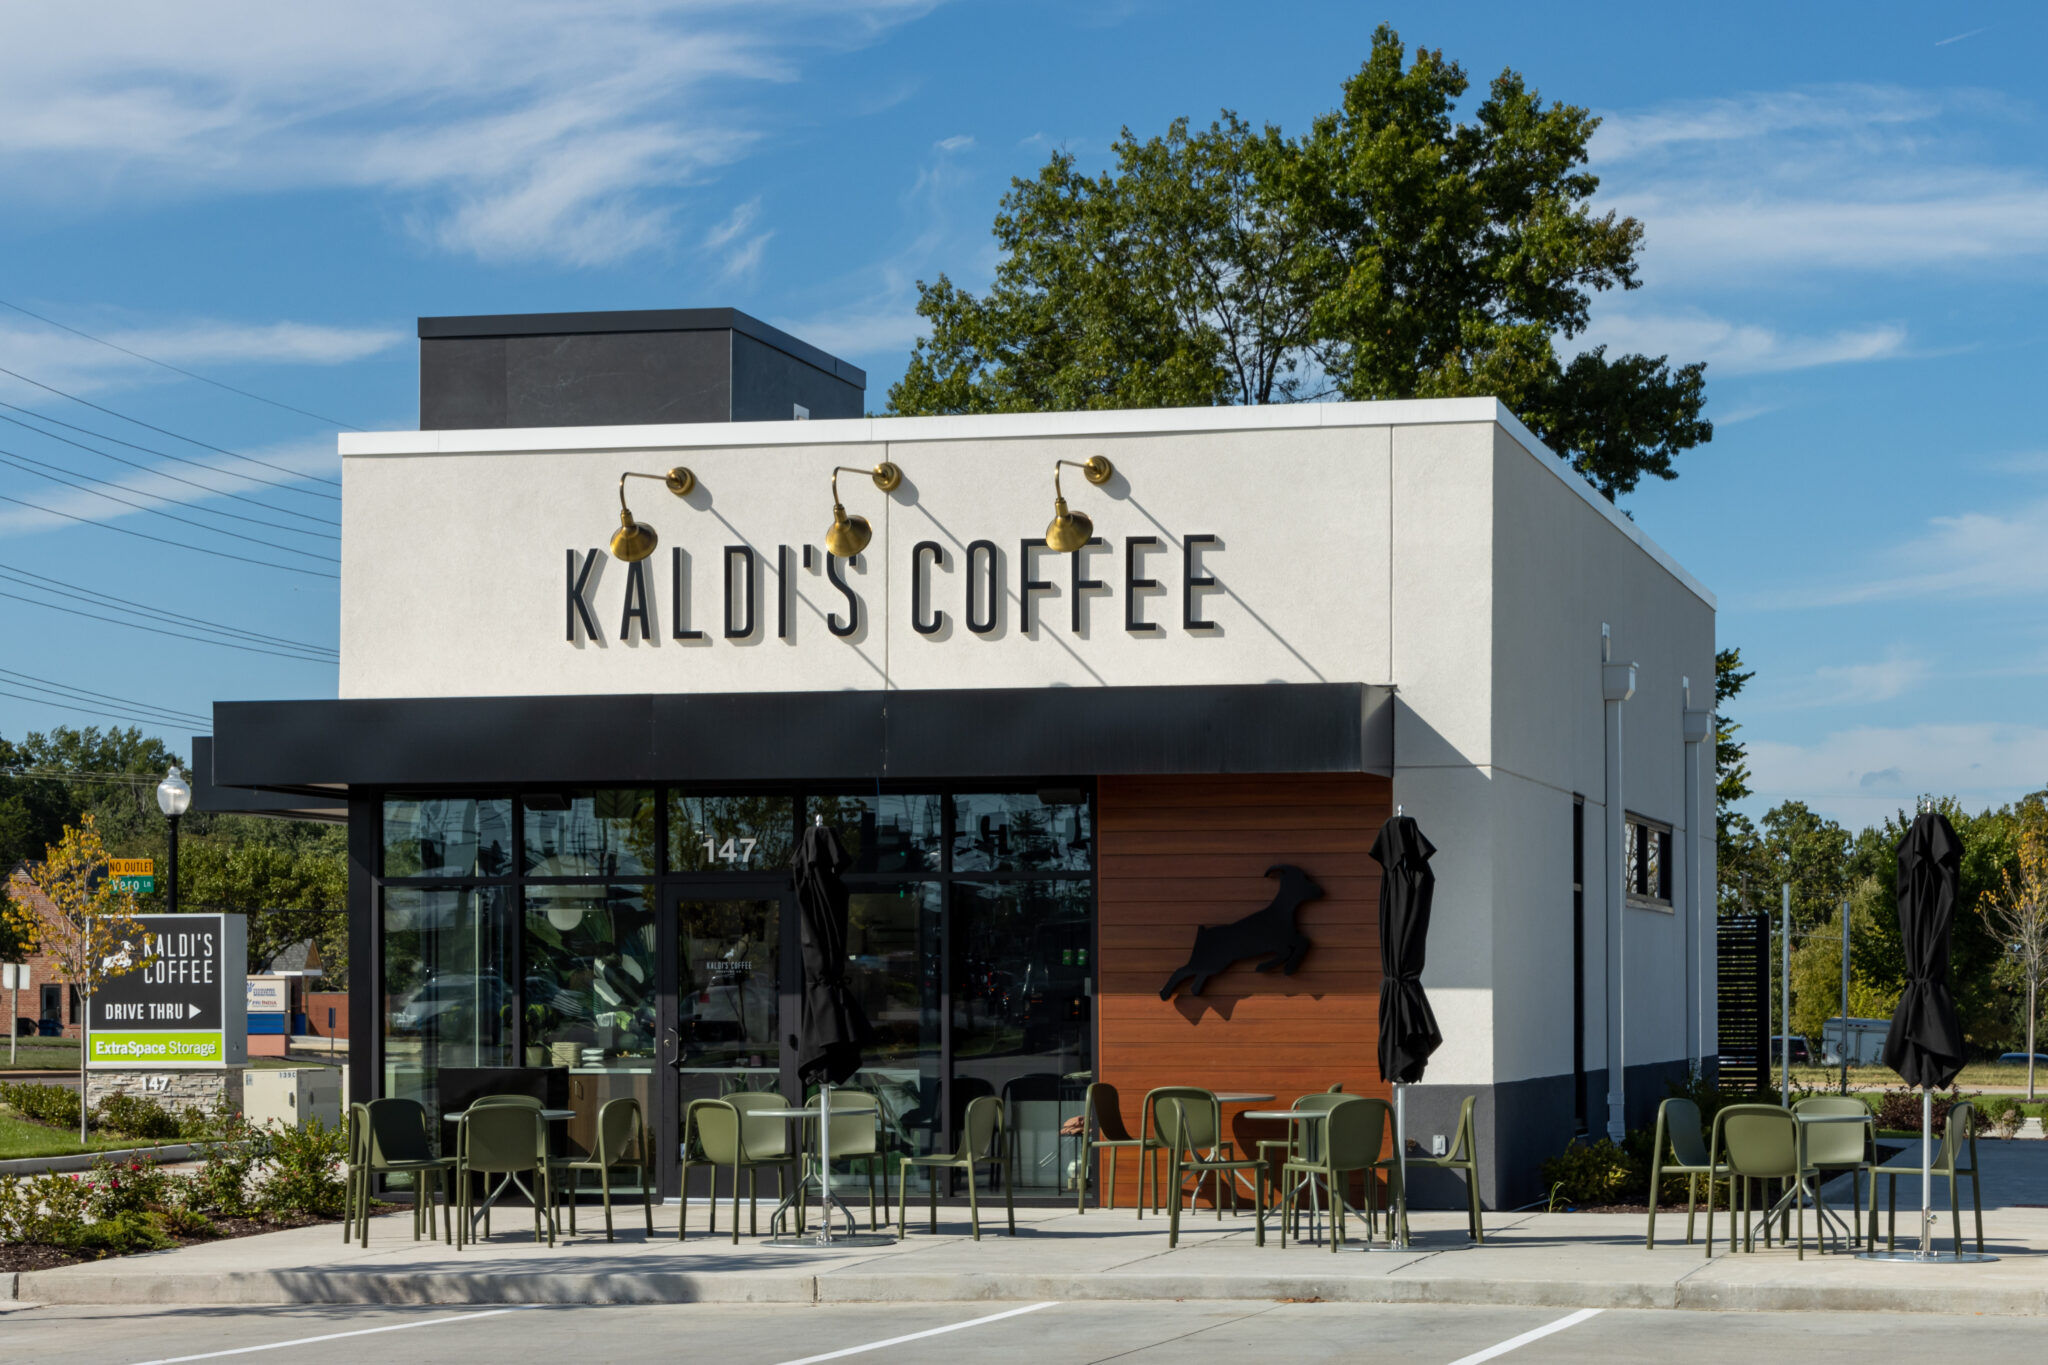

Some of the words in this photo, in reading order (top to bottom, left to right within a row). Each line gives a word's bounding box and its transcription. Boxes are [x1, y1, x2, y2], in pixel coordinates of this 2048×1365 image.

[566, 543, 860, 641] KALDI'S
[911, 533, 1216, 636] COFFEE
[702, 838, 757, 863] 147
[110, 862, 121, 873] NO
[124, 862, 153, 873] OUTLET
[112, 879, 140, 892] Vero
[144, 933, 213, 957] KALDI'S
[144, 959, 213, 984] COFFEE
[706, 961, 728, 970] KALDI'S
[730, 961, 752, 970] COFFEE
[105, 1003, 145, 1020] DRIVE
[148, 1003, 184, 1020] THRU
[95, 1041, 166, 1057] ExtraSpace
[168, 1041, 216, 1057] Storage
[140, 1076, 170, 1091] 147
